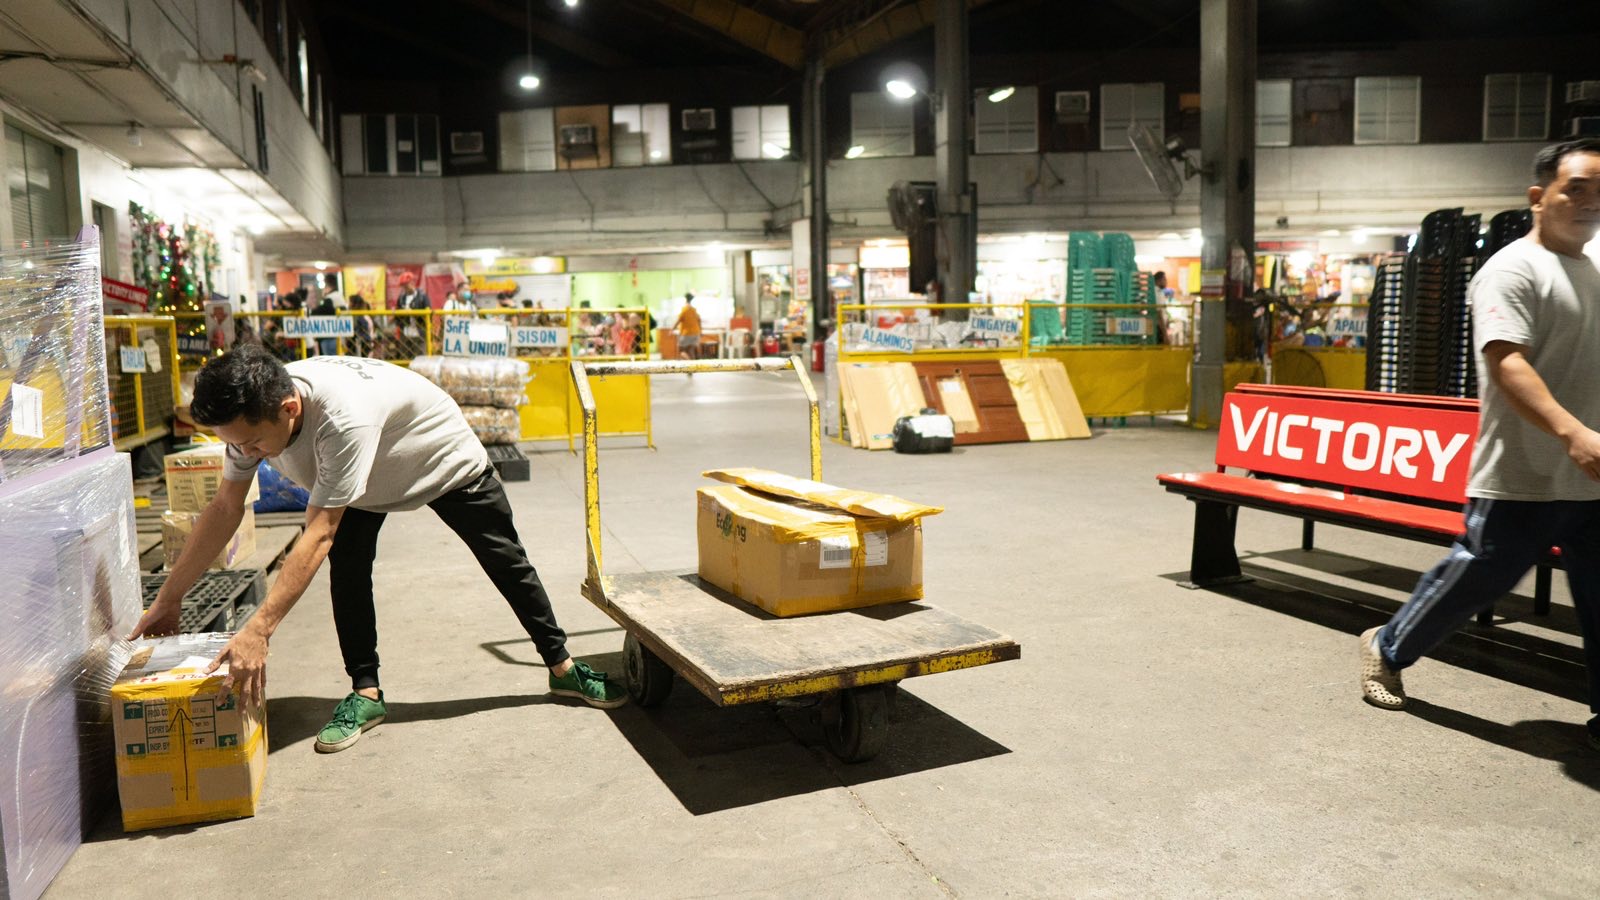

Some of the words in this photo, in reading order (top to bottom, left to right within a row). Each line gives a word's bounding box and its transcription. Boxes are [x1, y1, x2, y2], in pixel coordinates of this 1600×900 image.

[286, 319, 352, 335] CABANATUAN
[446, 319, 470, 334] SnFE
[971, 316, 1018, 333] LINGAYEN
[1335, 319, 1366, 333] APALI
[517, 330, 557, 344] SISON
[862, 328, 913, 351] ALAMINOS
[445, 338, 463, 354] LA
[469, 341, 507, 357] UNION
[1229, 402, 1470, 483] VICTORY
